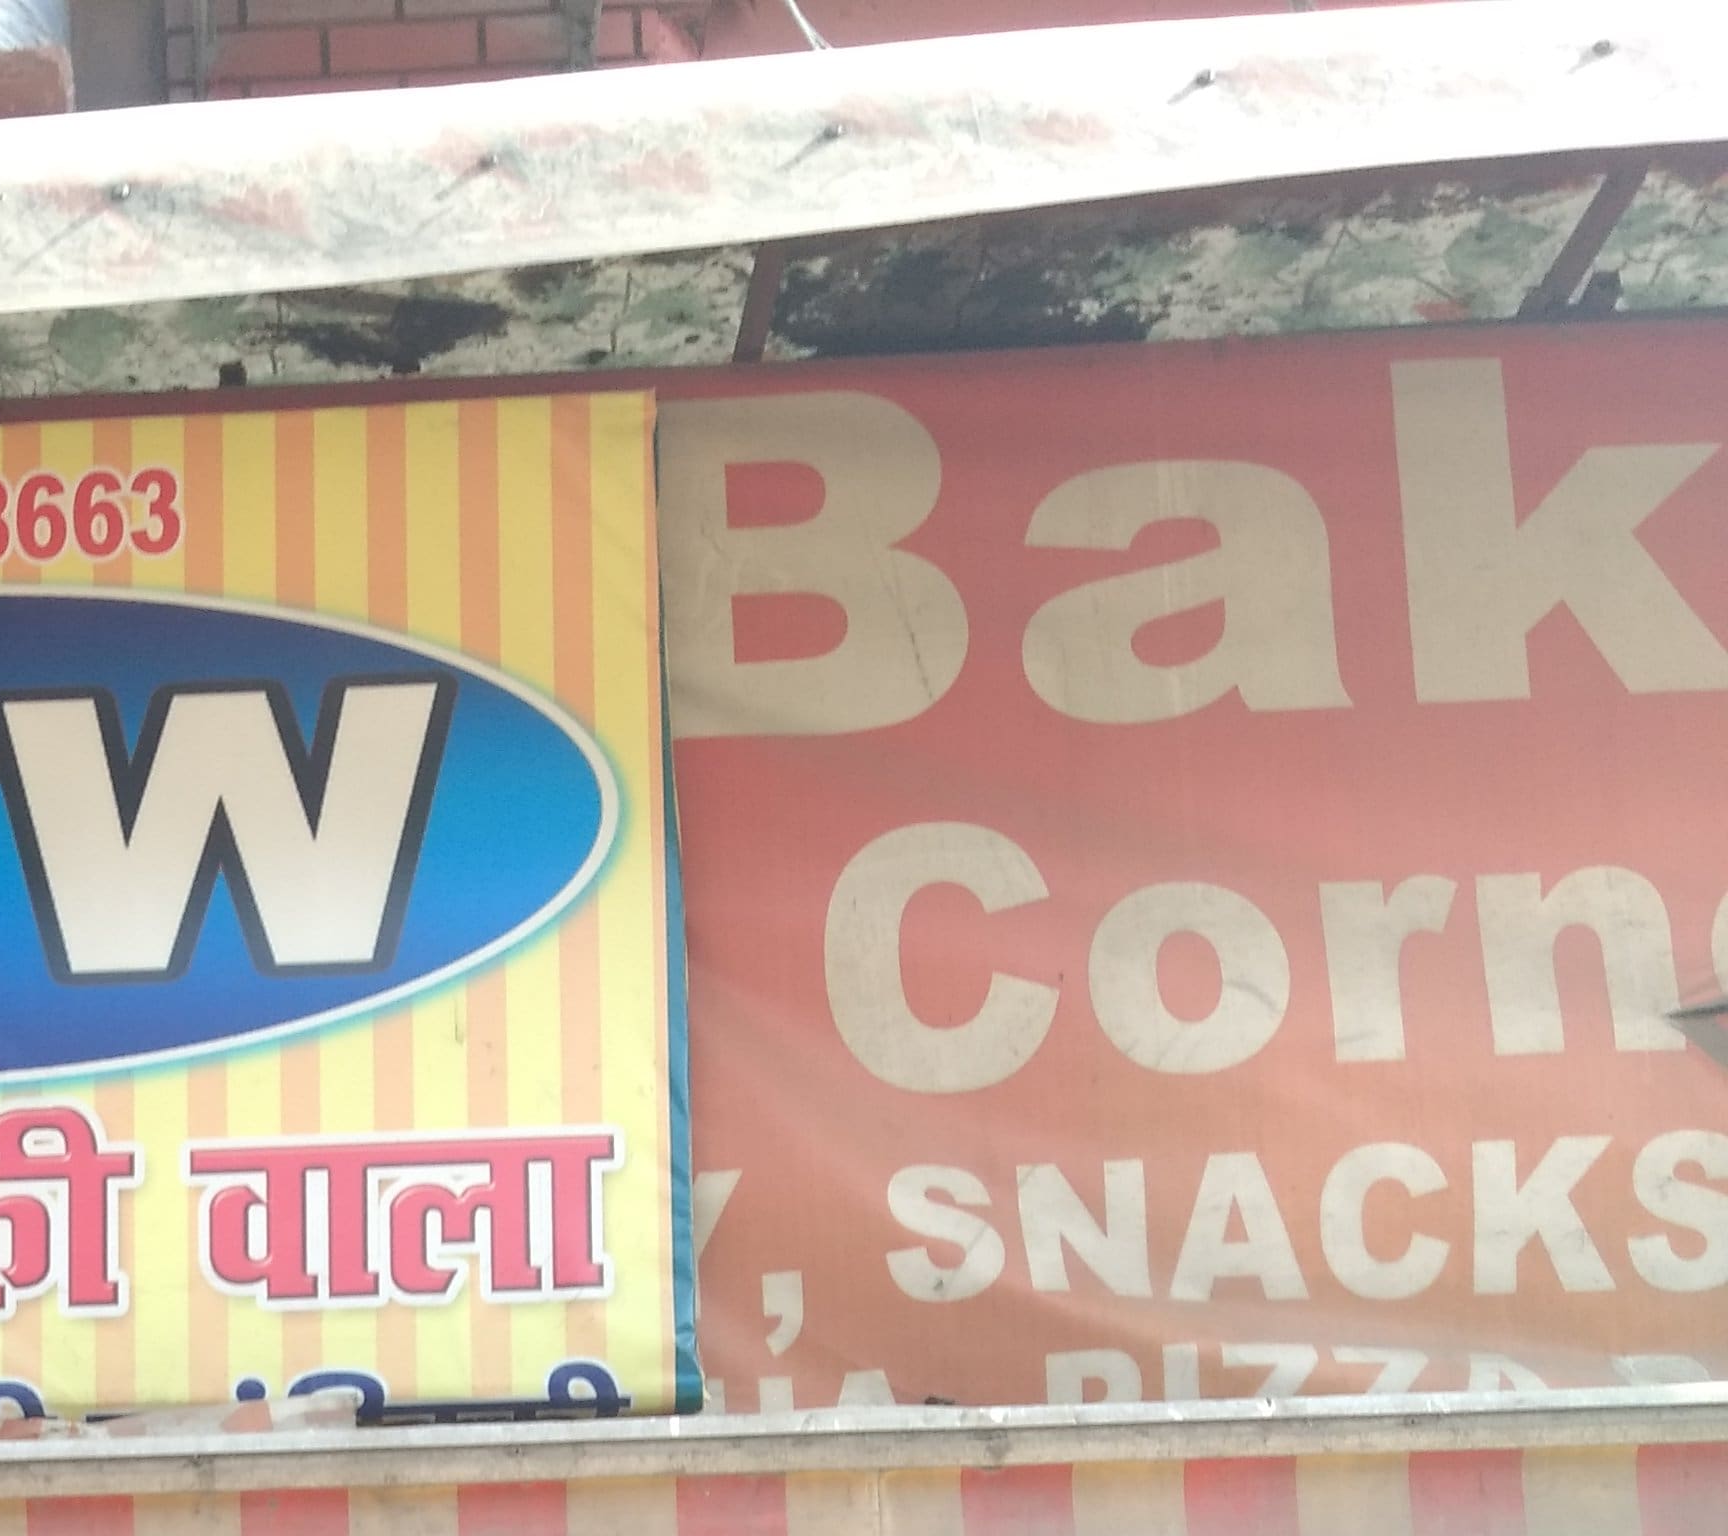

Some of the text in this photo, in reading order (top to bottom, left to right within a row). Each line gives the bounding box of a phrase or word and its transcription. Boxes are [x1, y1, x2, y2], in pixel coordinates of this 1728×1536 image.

[825, 821, 1728, 1095] Corn
[190, 1131, 616, 1305] वाला
[885, 1131, 1728, 1302] SNACKS
